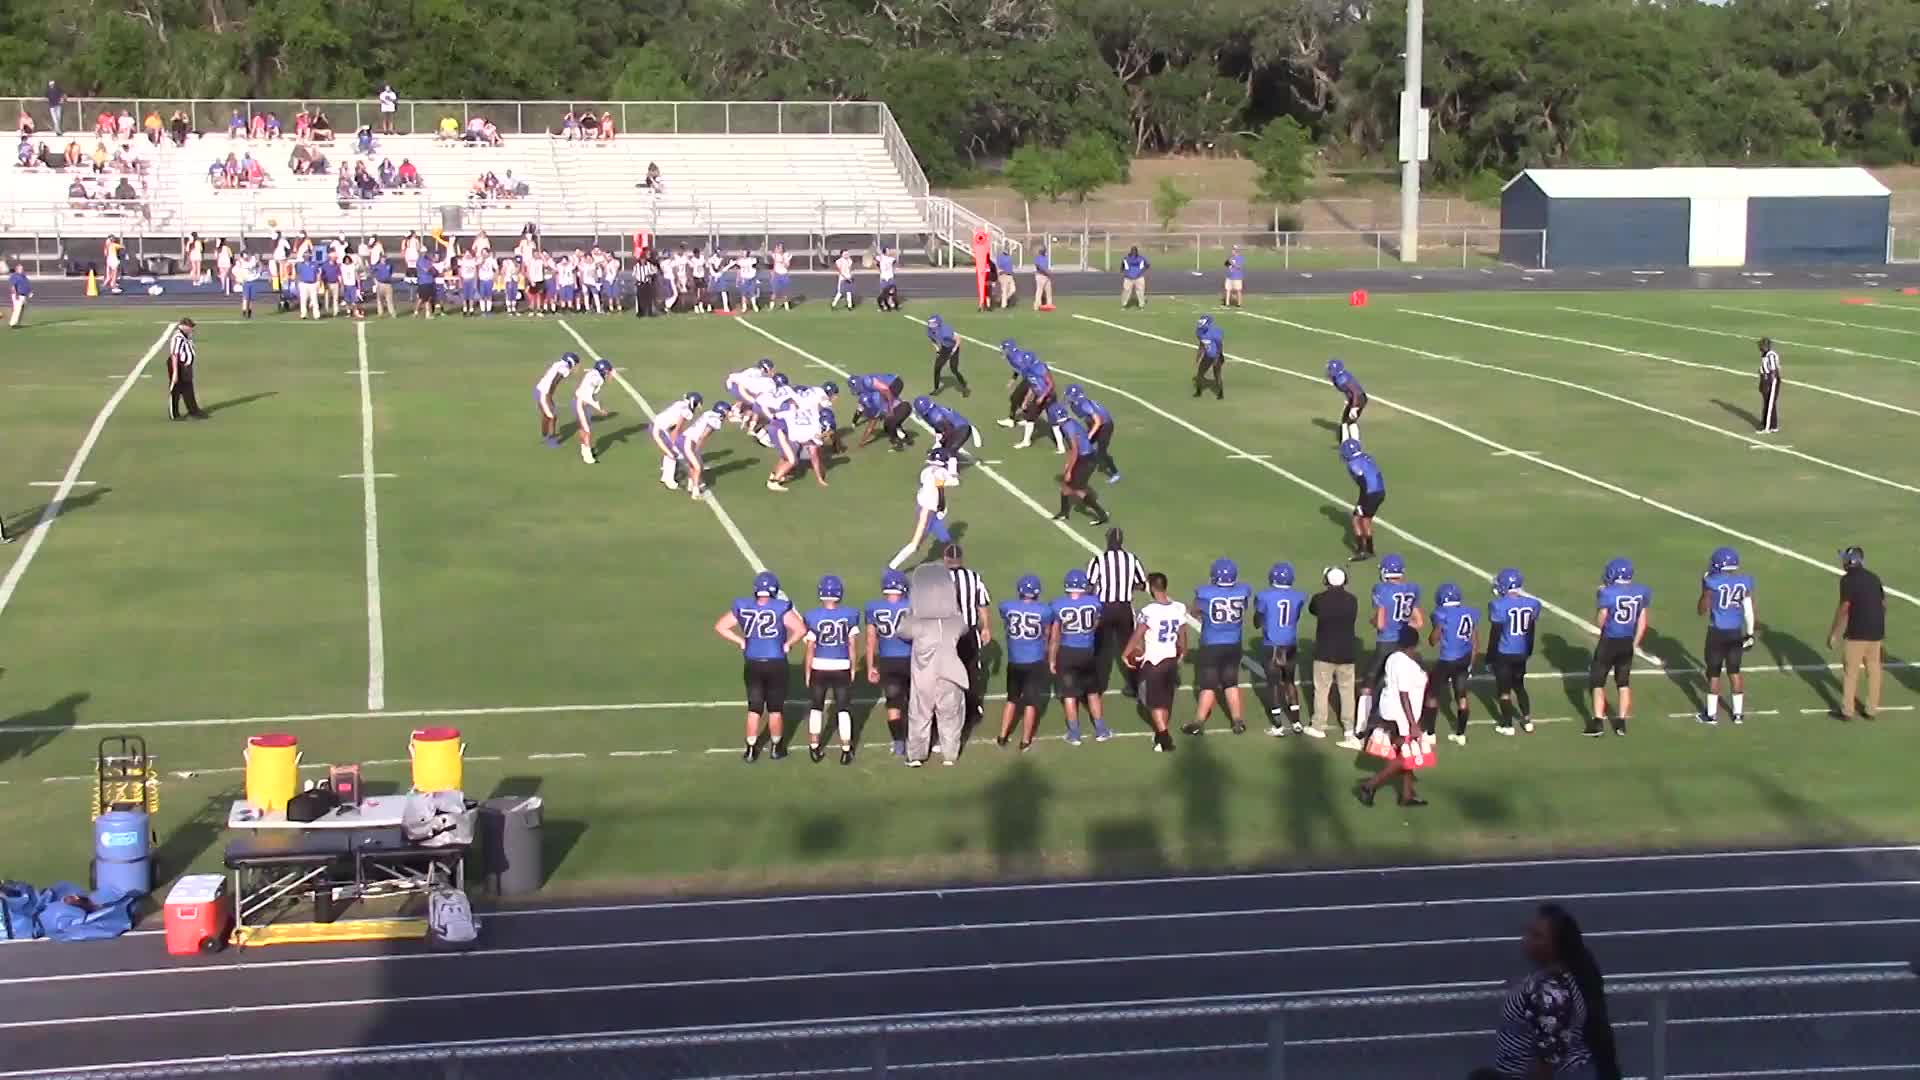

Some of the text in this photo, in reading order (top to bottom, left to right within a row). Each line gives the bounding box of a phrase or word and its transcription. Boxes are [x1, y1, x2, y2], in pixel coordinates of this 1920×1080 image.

[1717, 584, 1747, 609] 14
[739, 608, 778, 638] 72
[1059, 605, 1097, 634] 20
[1209, 597, 1245, 624] 65
[1277, 600, 1291, 627] 1
[1508, 607, 1534, 636] 10
[816, 619, 850, 646] 21
[1005, 610, 1041, 640] 35
[1158, 619, 1180, 643] 25
[1457, 613, 1474, 641] 4
